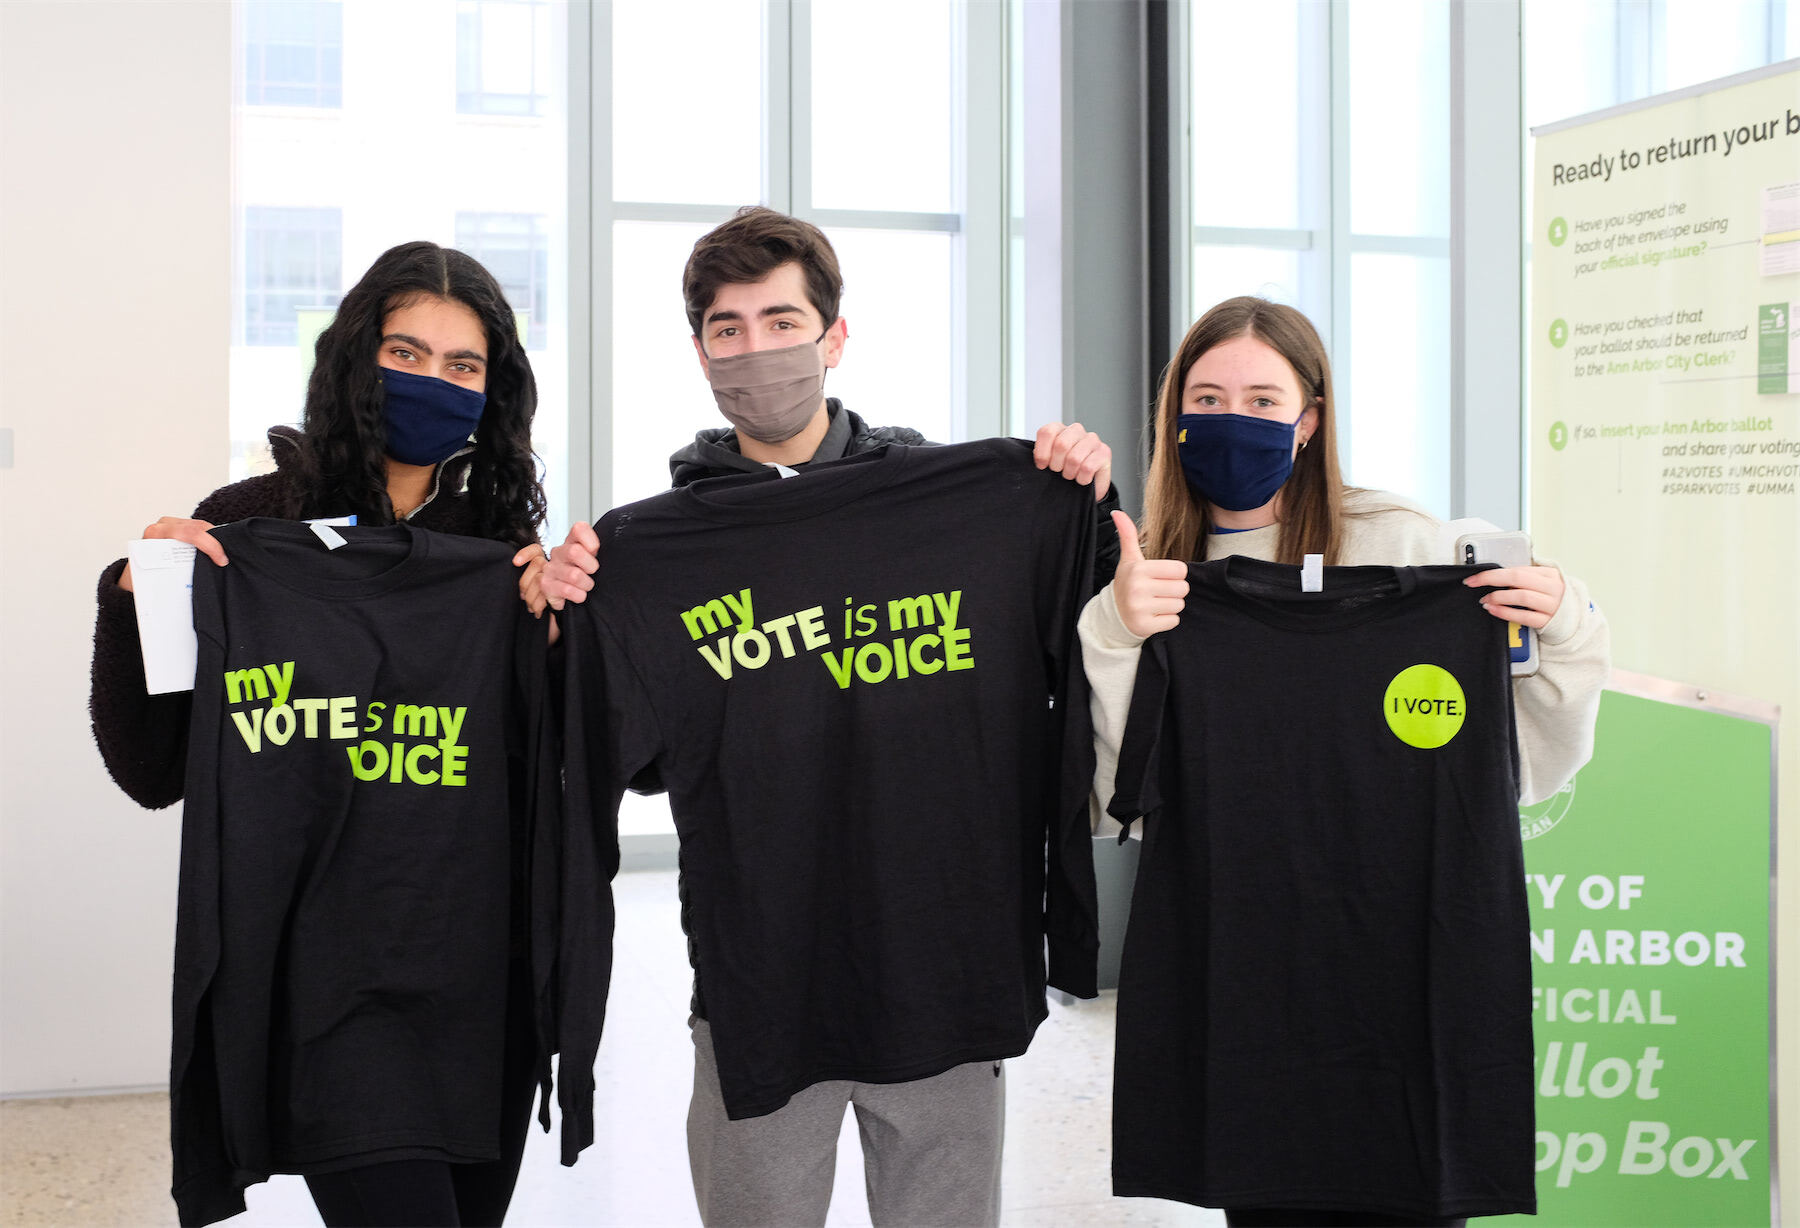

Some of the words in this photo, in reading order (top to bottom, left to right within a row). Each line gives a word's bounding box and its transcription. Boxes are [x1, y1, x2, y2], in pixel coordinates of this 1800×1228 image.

[1552, 154, 1615, 186] Ready
[1620, 149, 1641, 172] to
[1647, 133, 1717, 166] return
[1723, 117, 1780, 156] your
[1574, 219, 1601, 234] Have
[1604, 215, 1625, 232] you
[1627, 204, 1667, 226] signed
[1667, 201, 1687, 217] the
[1574, 237, 1602, 254] back
[1603, 233, 1617, 253] of
[1617, 232, 1636, 247] the
[1637, 224, 1690, 245] envelope
[1693, 216, 1729, 235] using
[1573, 260, 1599, 279] your
[1600, 251, 1639, 271] official
[1641, 240, 1708, 267] signature?
[1574, 321, 1602, 336] Have
[1603, 320, 1625, 336] you
[1626, 312, 1674, 330] checked
[1676, 309, 1703, 324] that
[1573, 345, 1598, 360] your
[1599, 338, 1633, 354] ballot
[1635, 332, 1672, 350] should
[1674, 332, 1691, 346] be
[1694, 325, 1748, 344] returned
[1574, 365, 1585, 377] to
[1586, 362, 1604, 376] the
[1606, 360, 1630, 374] Ann
[1631, 357, 1664, 372] Arbor
[1665, 354, 1691, 372] City
[1693, 350, 1736, 367] Clerk?
[1574, 424, 1582, 443] If
[1600, 424, 1634, 438] insert
[1636, 425, 1660, 440] your
[1662, 420, 1688, 435] Ann
[1690, 418, 1729, 434] Arbor
[1730, 417, 1773, 433] ballot
[1662, 441, 1687, 456] and
[1689, 439, 1726, 456] share
[1728, 441, 1756, 459] your
[1759, 439, 1800, 458] voting
[1662, 465, 1723, 478] #A2VOTES
[1728, 464, 1800, 478] #UMICHVOT
[1662, 483, 1740, 495] #SPARKVOTES
[1746, 482, 1795, 495] #UMMA
[680, 587, 755, 641] my
[697, 605, 831, 681] VOTE
[844, 596, 878, 640] is
[887, 589, 962, 637] my
[821, 627, 975, 690] VOICE
[223, 661, 296, 708] my
[230, 696, 359, 754] VOTE
[392, 703, 468, 750] my
[1393, 697, 1398, 714] I
[1404, 697, 1462, 716] VOTE.
[1578, 874, 1645, 911] OF
[1568, 929, 1747, 968] ARBOR
[1535, 1041, 1664, 1100] llot
[1617, 1120, 1758, 1181] Box
